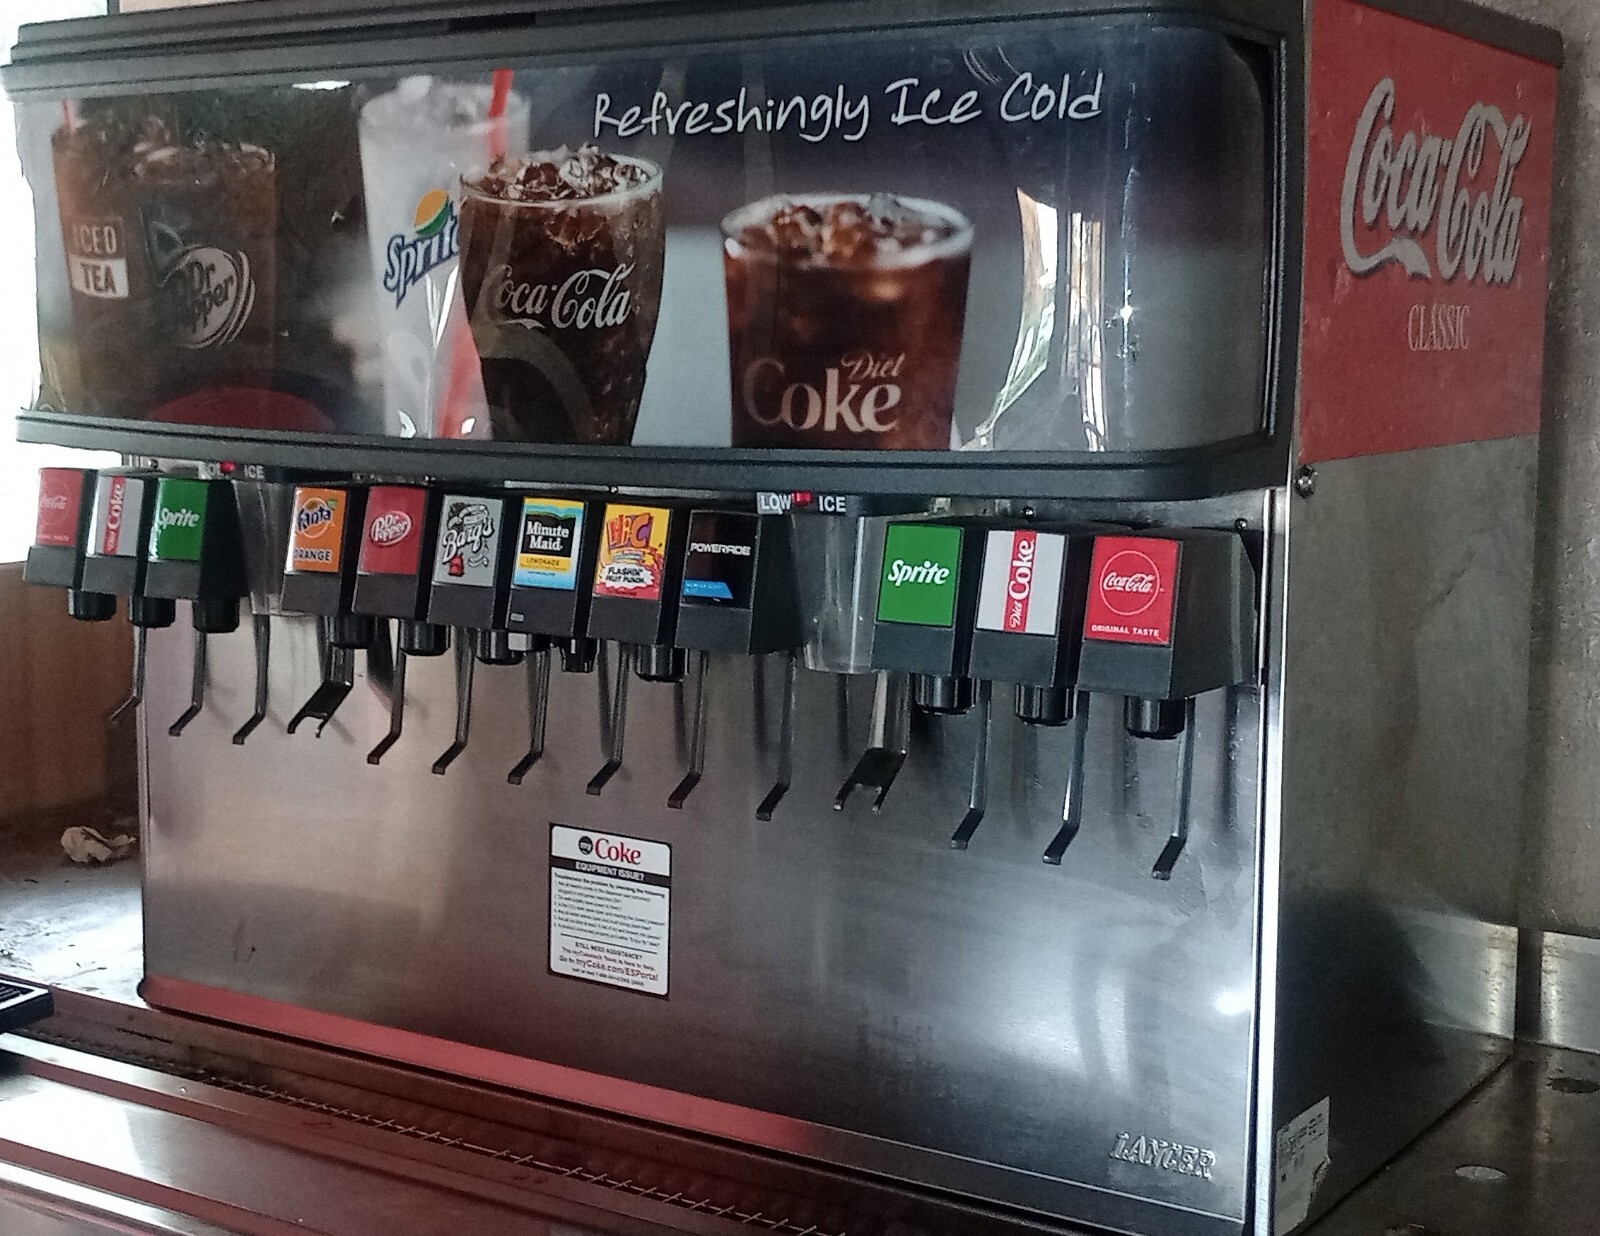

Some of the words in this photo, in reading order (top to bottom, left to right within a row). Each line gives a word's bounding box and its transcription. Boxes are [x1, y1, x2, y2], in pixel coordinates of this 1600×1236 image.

[593, 84, 870, 142] Refreshingly
[884, 78, 983, 127] Ice
[1000, 72, 1105, 123] Cold
[384, 201, 460, 310] Sprit
[80, 261, 118, 295] TEA
[1407, 303, 1471, 351] CLASSIC
[841, 352, 906, 381] Diet
[743, 358, 902, 433] Coke
[243, 464, 265, 480] ICE
[760, 493, 792, 511] LOW
[818, 495, 847, 513] ICE
[160, 507, 200, 530] Sprite
[526, 521, 570, 539] Minute
[442, 517, 495, 565] Barq's
[529, 536, 562, 551] Maid
[690, 542, 752, 556] POWERADE
[887, 559, 951, 587] Sprite
[1008, 540, 1035, 600] Coke
[1103, 571, 1155, 593] Coca-Cola
[1009, 601, 1023, 628] Diet
[1091, 624, 1130, 635] ORIGINAL
[1132, 626, 1160, 637] TASTE
[595, 837, 642, 865] Coke
[575, 861, 618, 877] EQUIPMENT
[1108, 1132, 1216, 1180] LANCER
